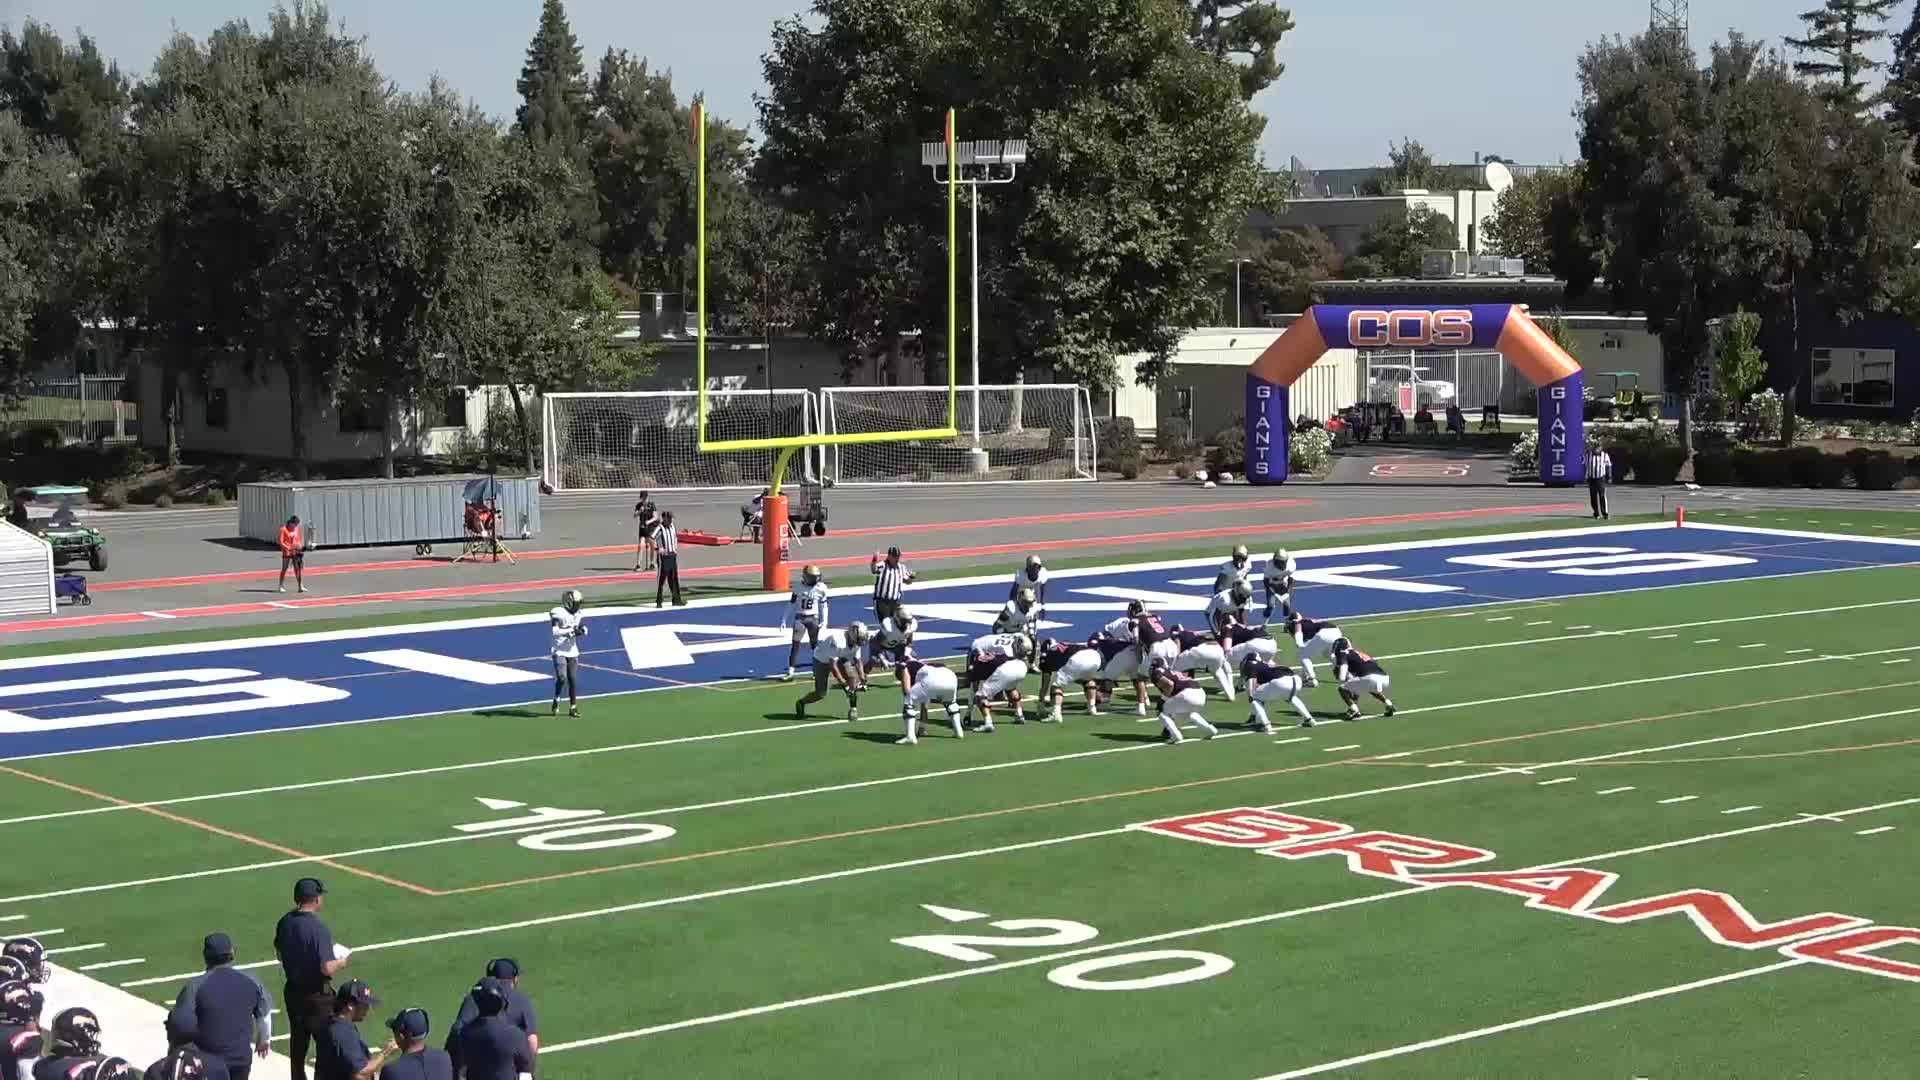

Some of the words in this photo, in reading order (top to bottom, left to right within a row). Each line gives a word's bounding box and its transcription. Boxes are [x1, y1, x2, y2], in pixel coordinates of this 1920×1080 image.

[1348, 309, 1474, 347] COS
[1255, 385, 1271, 475] GIANTS
[1551, 386, 1566, 477] GIANTS
[453, 807, 677, 851] 10
[890, 917, 1236, 991] 20
